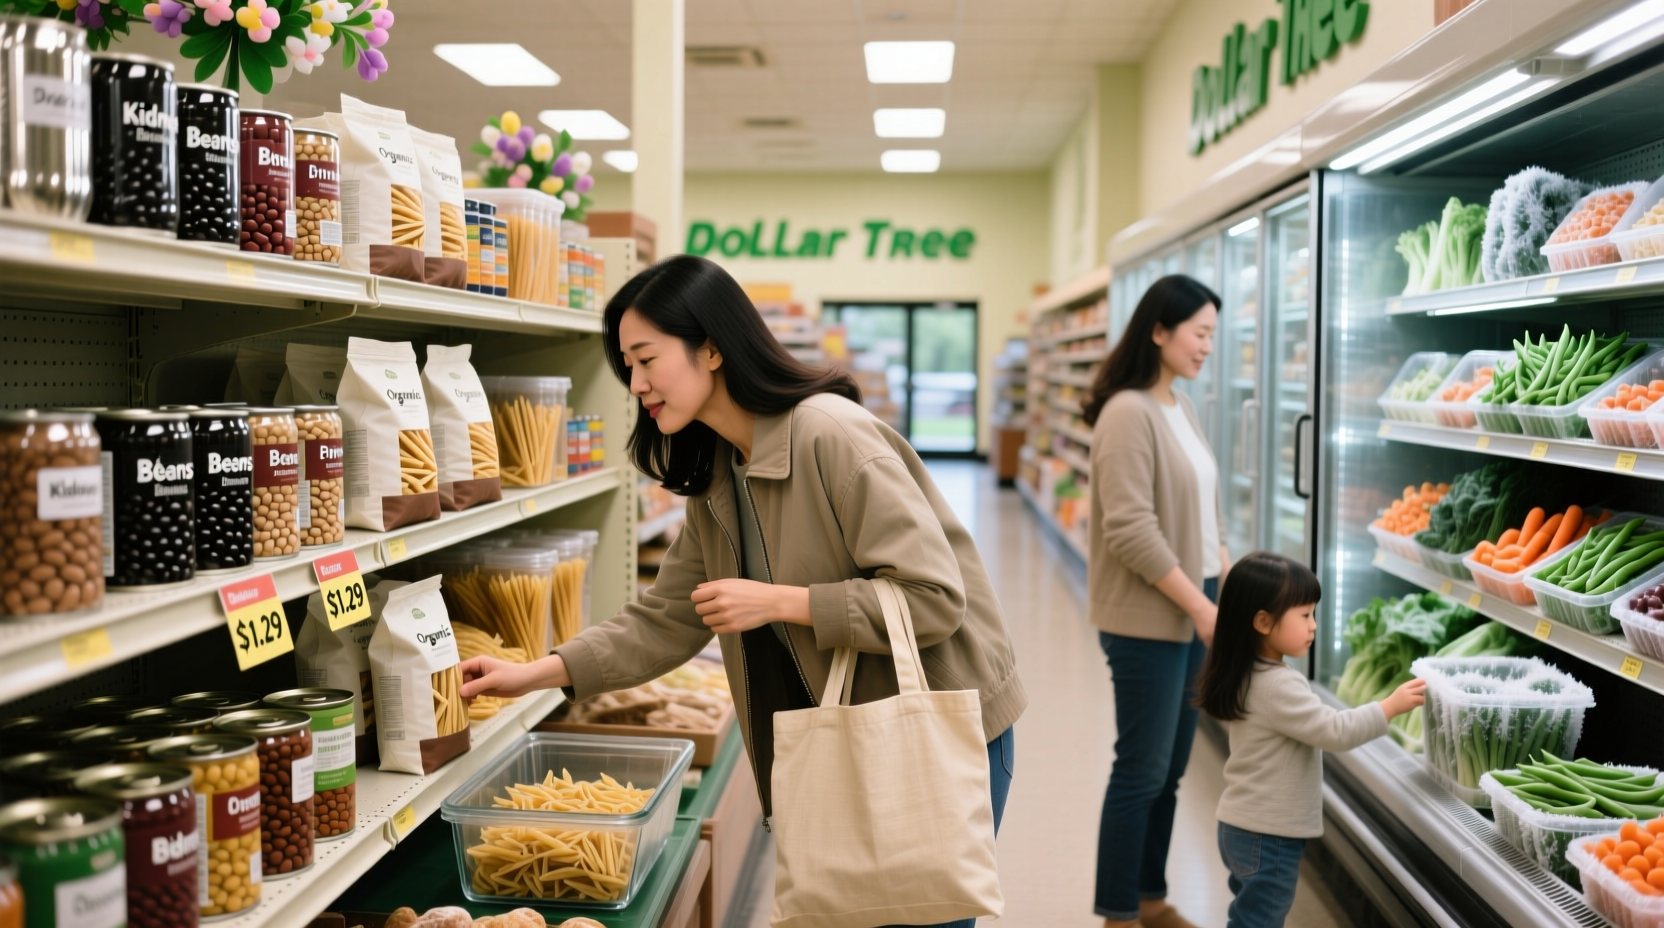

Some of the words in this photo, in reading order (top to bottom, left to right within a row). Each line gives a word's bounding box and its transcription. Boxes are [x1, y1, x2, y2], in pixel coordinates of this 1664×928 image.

[186, 126, 240, 153] Beans
[208, 452, 253, 474] Beans
[327, 582, 364, 619] $1.29
[236, 610, 282, 655] $1.29
